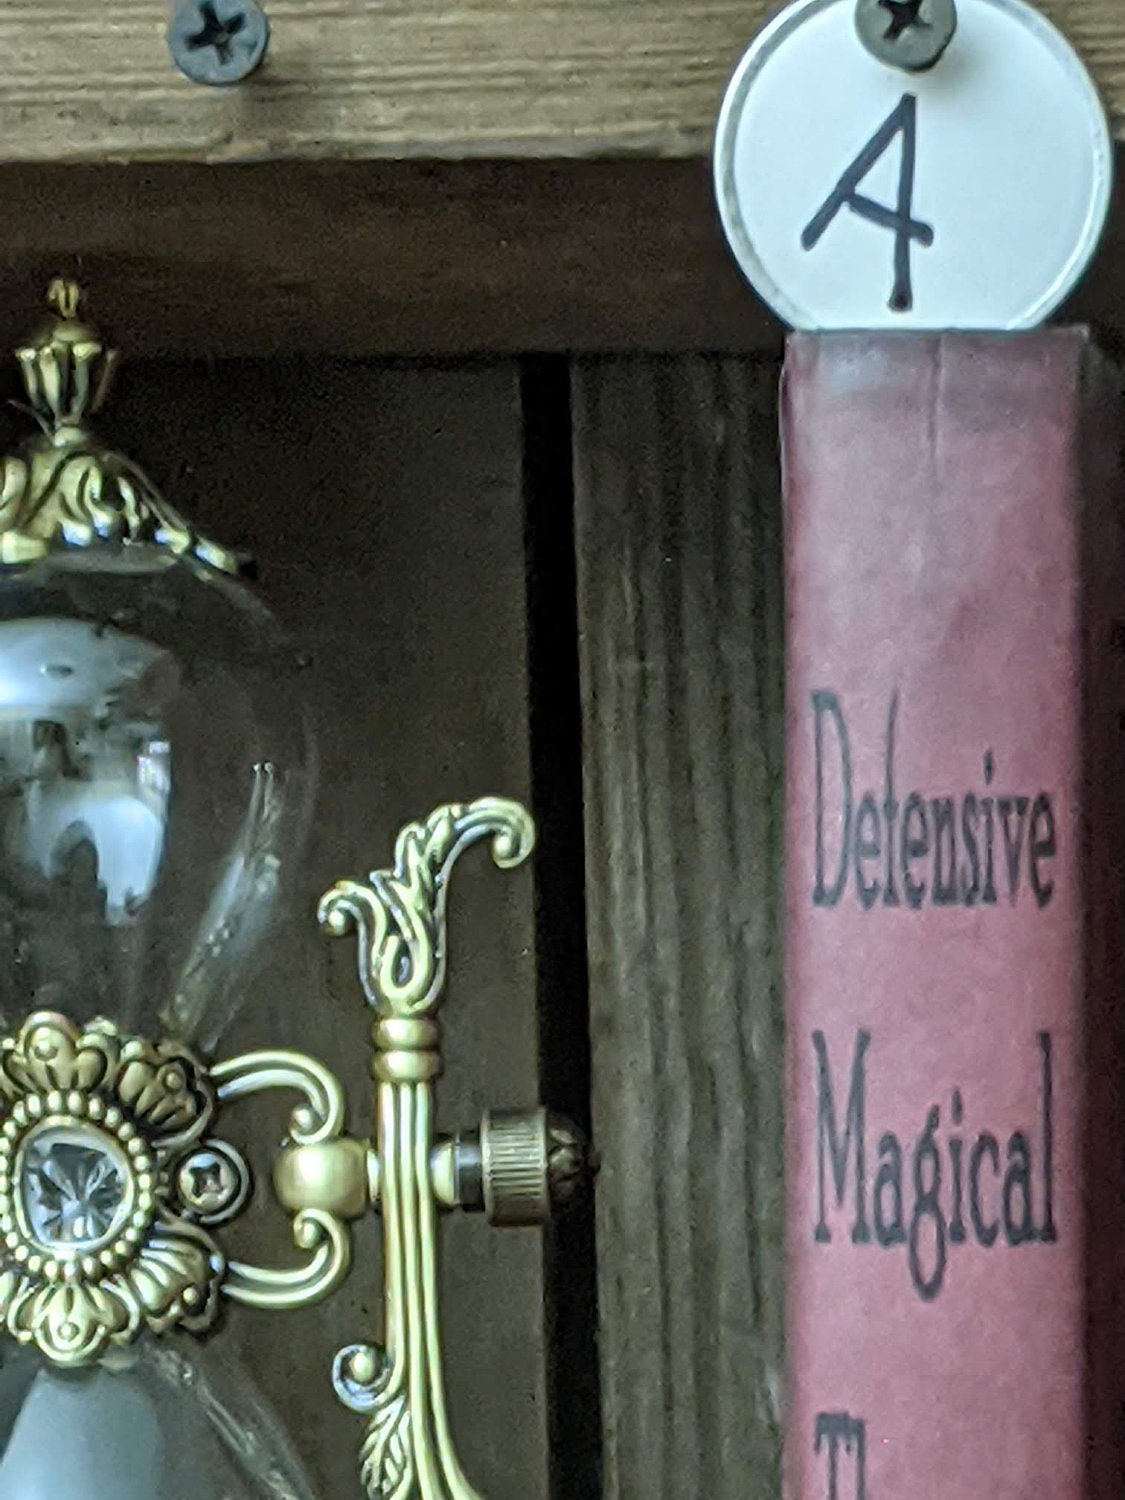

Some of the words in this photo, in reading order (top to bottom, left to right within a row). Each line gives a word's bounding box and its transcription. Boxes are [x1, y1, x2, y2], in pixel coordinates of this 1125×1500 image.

[800, 92, 935, 312] A
[810, 688, 1056, 908] Defensive
[812, 1030, 1058, 1302] Magical
